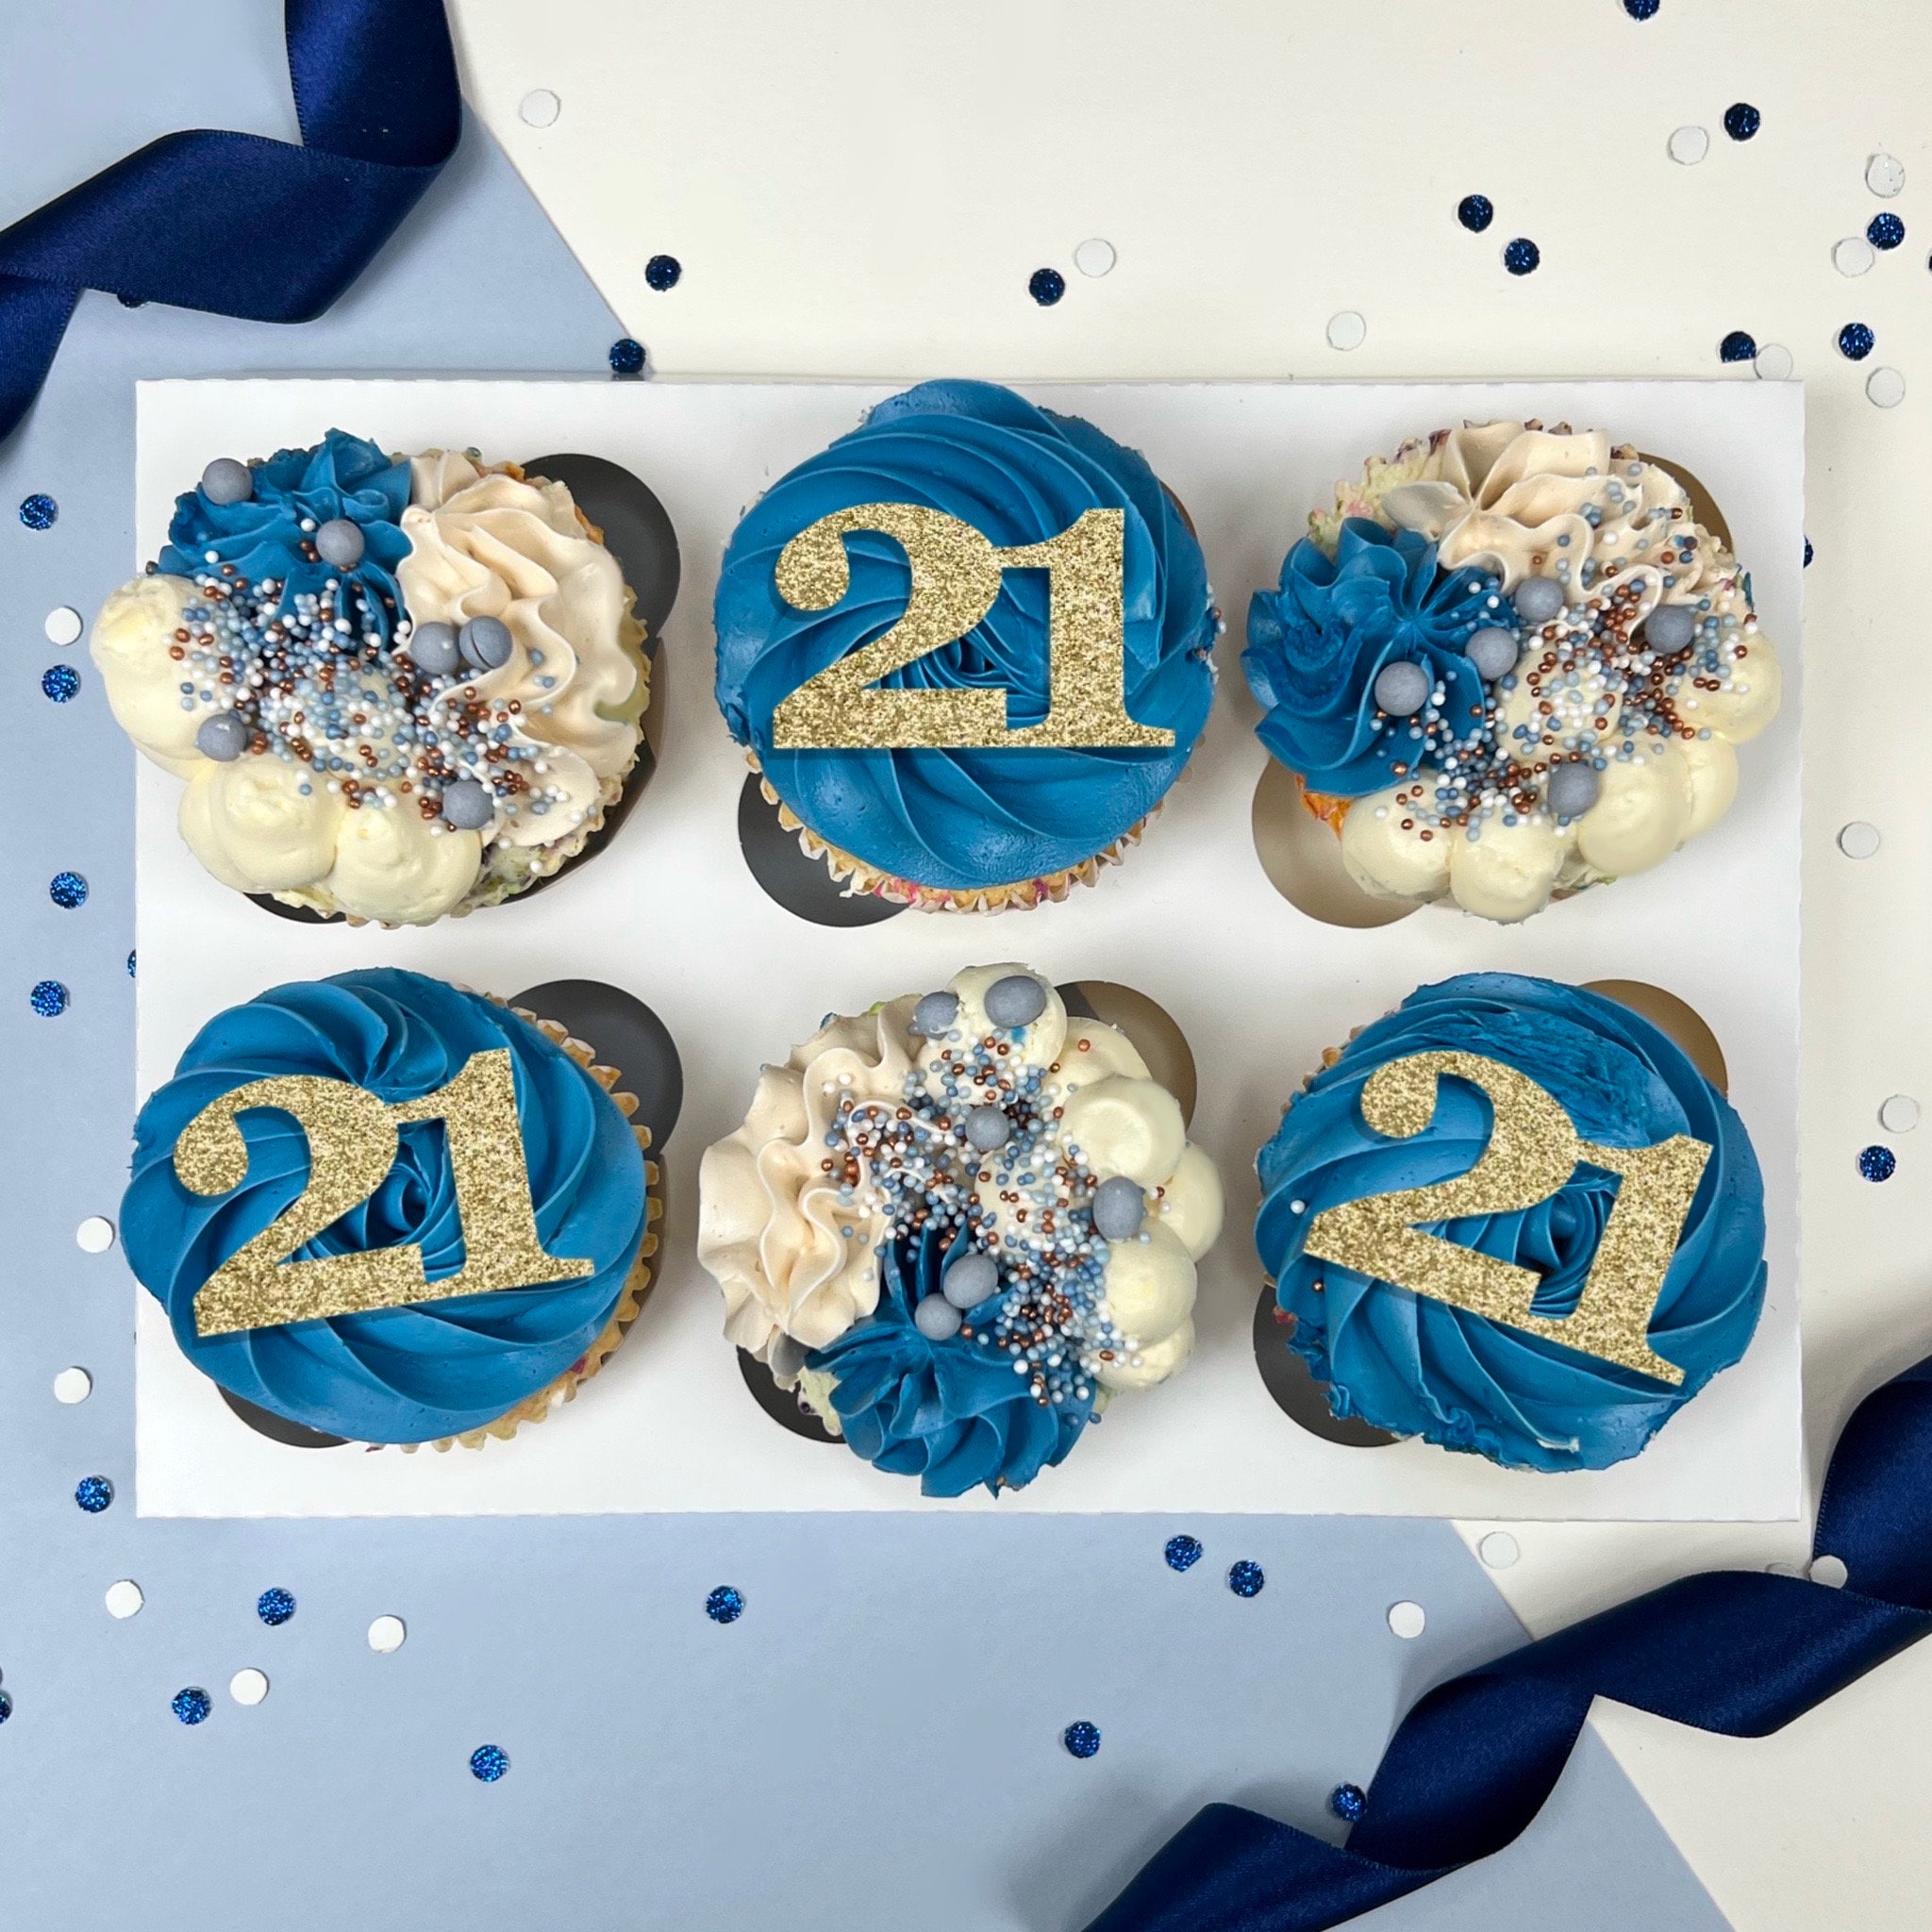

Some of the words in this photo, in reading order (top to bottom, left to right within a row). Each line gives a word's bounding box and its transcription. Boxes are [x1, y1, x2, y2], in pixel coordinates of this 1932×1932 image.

[774, 502, 1175, 750] 21
[174, 1048, 594, 1337] 21
[1303, 1050, 1714, 1385] 21
